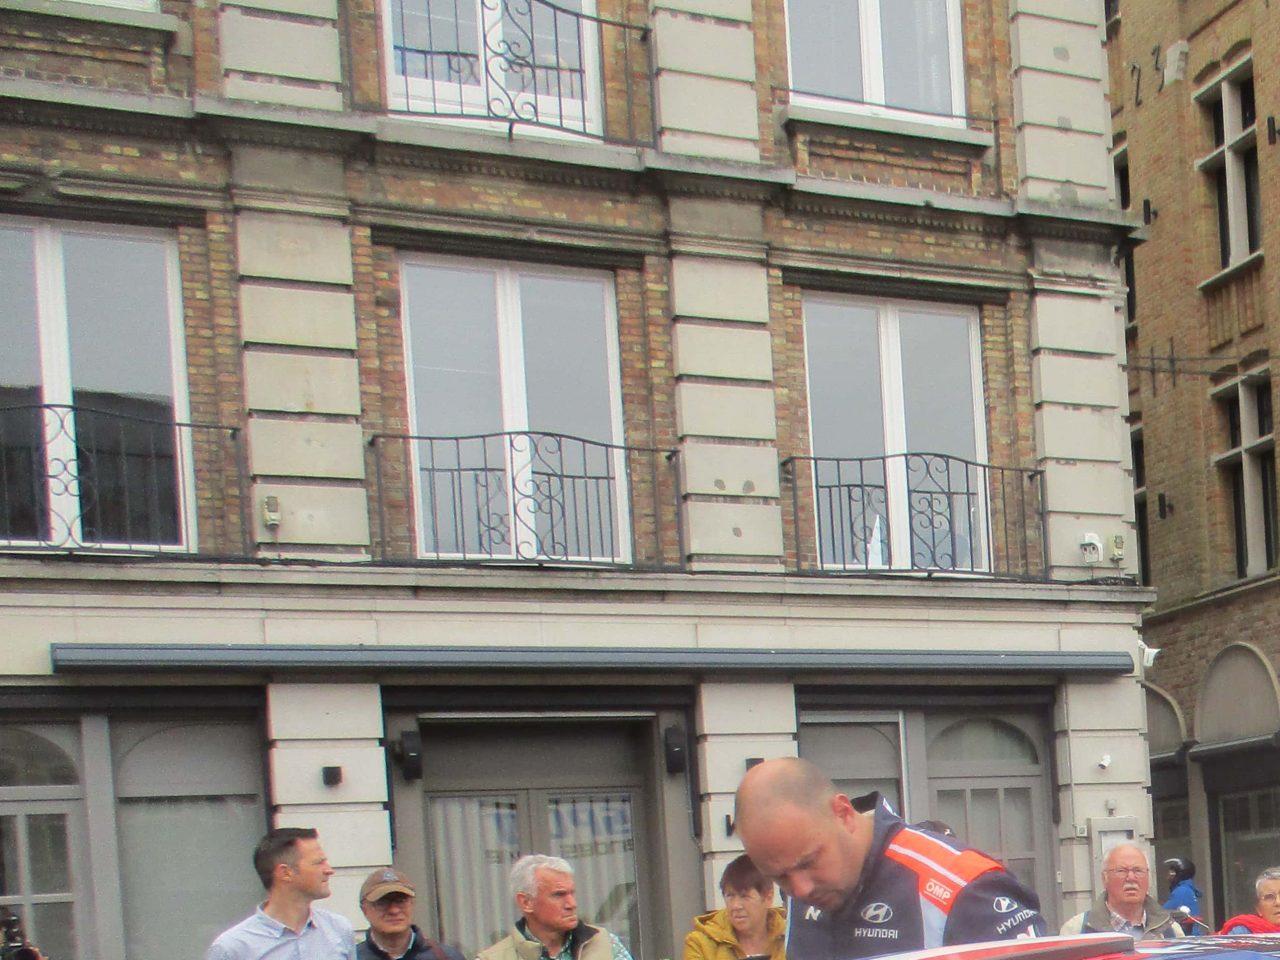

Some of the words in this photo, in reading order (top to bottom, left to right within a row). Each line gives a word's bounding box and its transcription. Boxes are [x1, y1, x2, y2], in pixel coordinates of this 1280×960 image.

[925, 881, 952, 900] OMP
[996, 908, 1039, 935] HYUNDA
[854, 927, 899, 939] HYUNDAI
